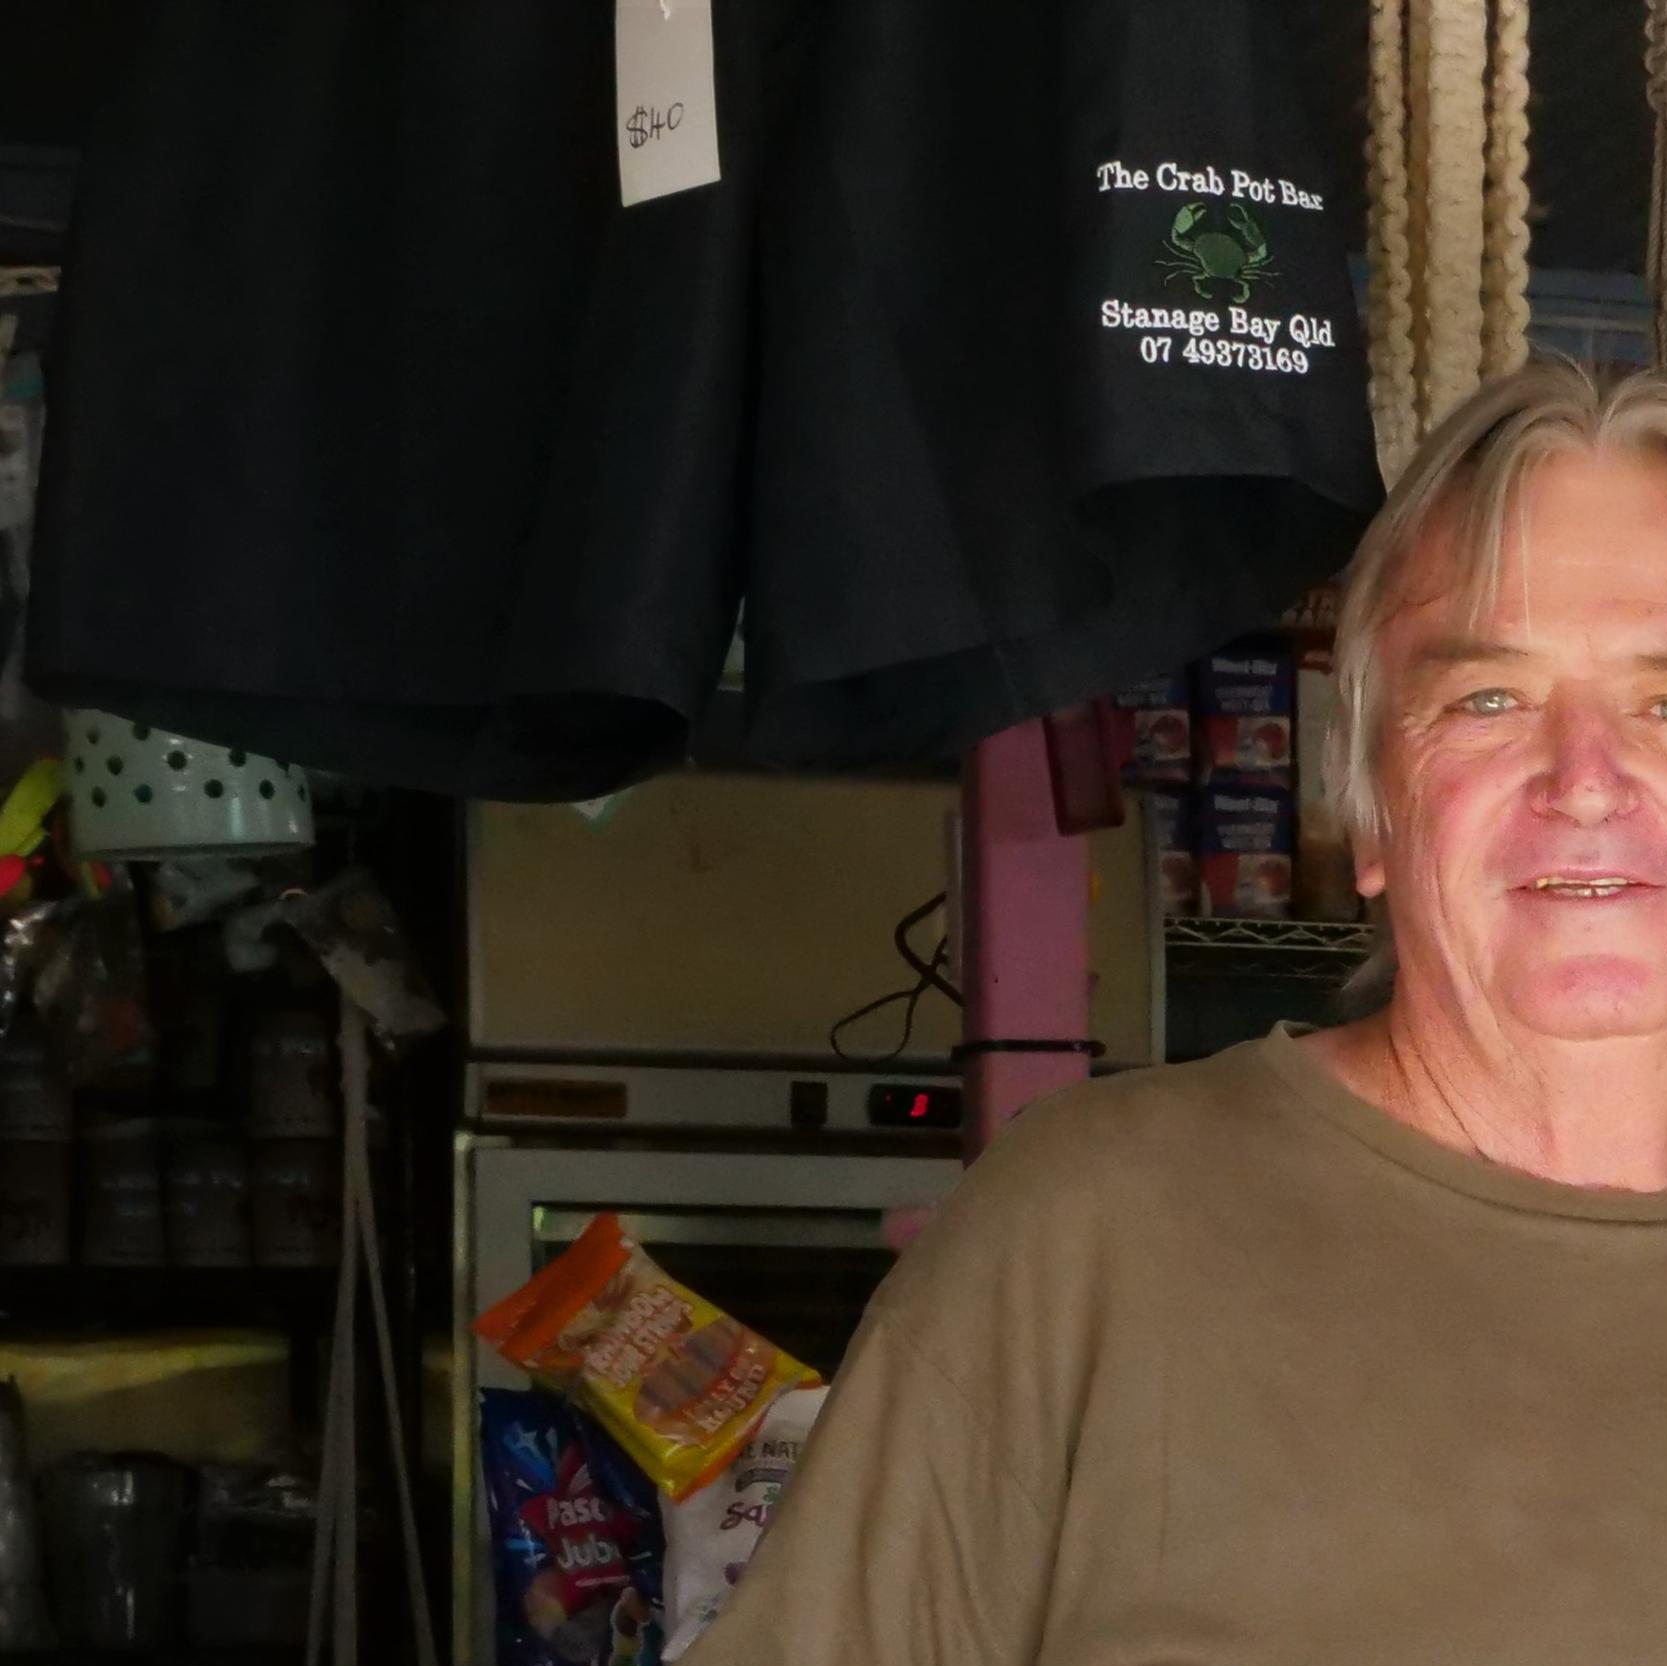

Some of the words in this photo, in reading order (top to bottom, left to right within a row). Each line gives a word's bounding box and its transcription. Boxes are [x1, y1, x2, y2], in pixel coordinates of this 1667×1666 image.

[625, 101, 685, 150] $40
[1096, 159, 1150, 192] The
[1155, 162, 1226, 196] Crab
[1229, 168, 1276, 204] Pot
[1278, 178, 1325, 212] Bar
[1101, 298, 1221, 337] Stanage
[1228, 305, 1281, 345] Bay
[1288, 313, 1336, 349] Qld
[1139, 336, 1172, 364] 07
[1182, 336, 1310, 375] 49373169
